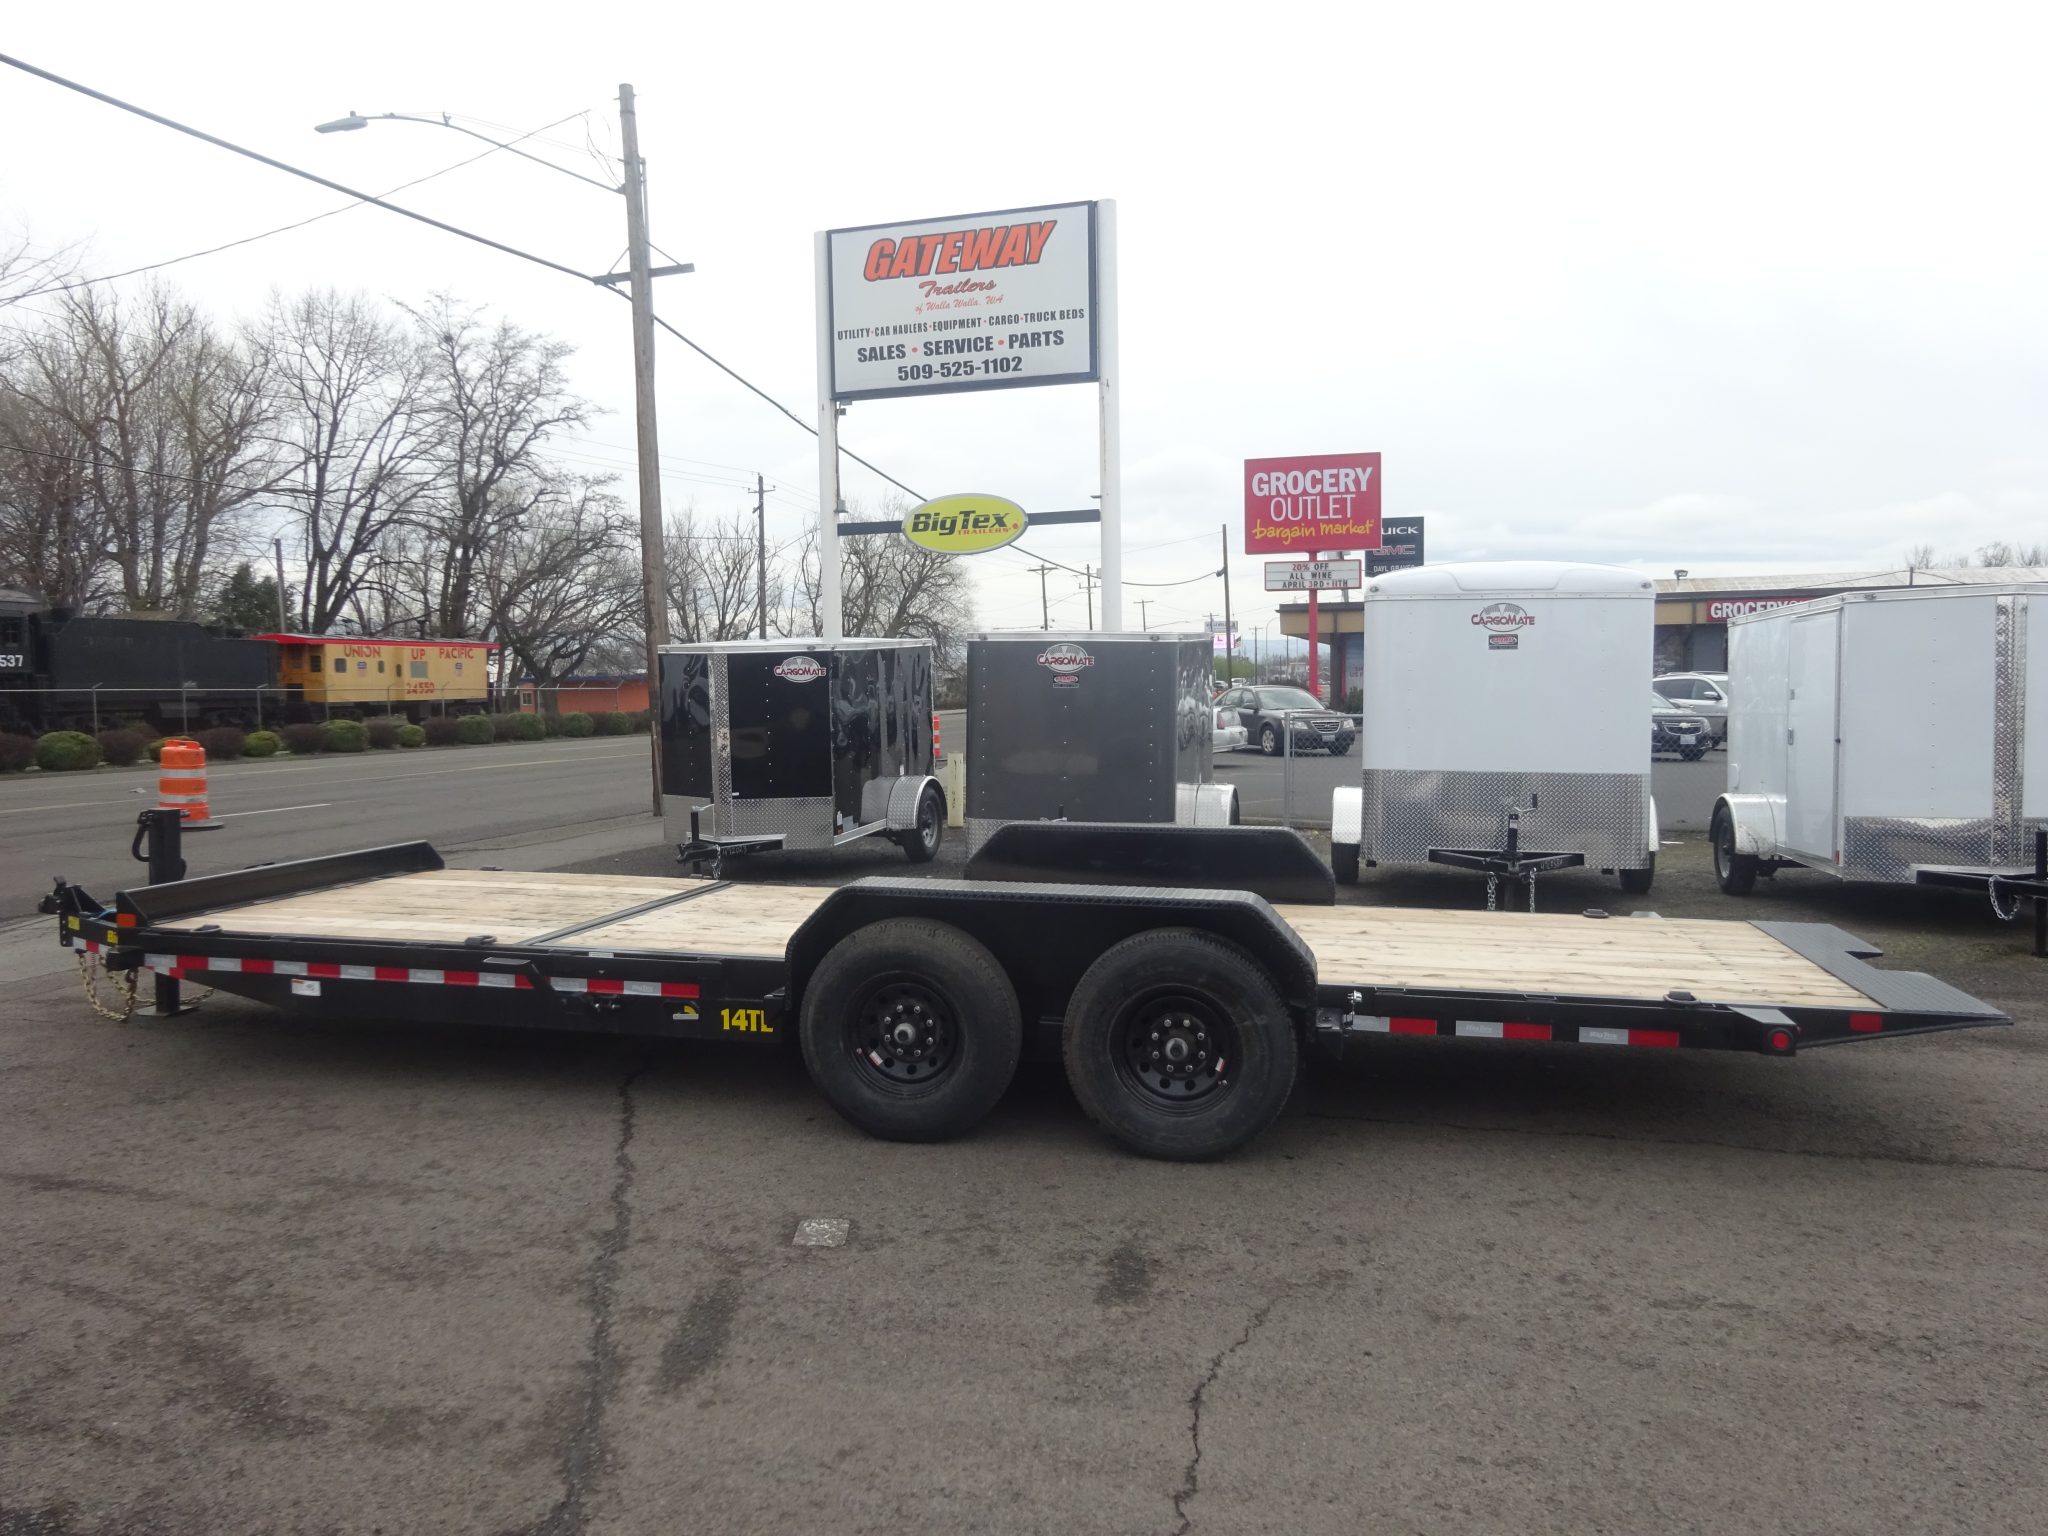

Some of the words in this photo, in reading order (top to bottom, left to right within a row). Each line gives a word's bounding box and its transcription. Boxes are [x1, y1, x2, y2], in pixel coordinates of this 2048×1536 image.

[864, 220, 1057, 282] GATEWAY
[919, 278, 996, 298] Trailers
[926, 301, 950, 311] Walla
[837, 328, 870, 340] UTILITY
[874, 326, 890, 337] CAR
[893, 322, 928, 335] HAULERS
[933, 317, 982, 331] EQUIPMENT
[989, 314, 1019, 326] CARGO
[1024, 310, 1056, 323] TRUCK
[1059, 308, 1084, 320] BEDS
[857, 344, 906, 363] SALES
[923, 336, 994, 356] SERVICE
[1008, 330, 1064, 349] PARTS
[898, 356, 1022, 381] 509-525-1102
[1252, 467, 1373, 496] GROCERY
[1270, 494, 1356, 521] OUTLET
[957, 527, 1009, 535] TRAILERS
[1252, 519, 1315, 545] bargain
[1320, 519, 1373, 537] market
[1382, 526, 1419, 535] UICK
[1292, 563, 1310, 571] 20%
[1289, 572, 1305, 580] ALL
[1311, 571, 1332, 579] WINE
[1282, 581, 1306, 589] APRIL
[344, 645, 381, 658] UNION
[411, 648, 426, 660] UP
[439, 648, 474, 660] PACIFIC
[0, 655, 23, 667] 537
[721, 1008, 773, 1032] 14TL
